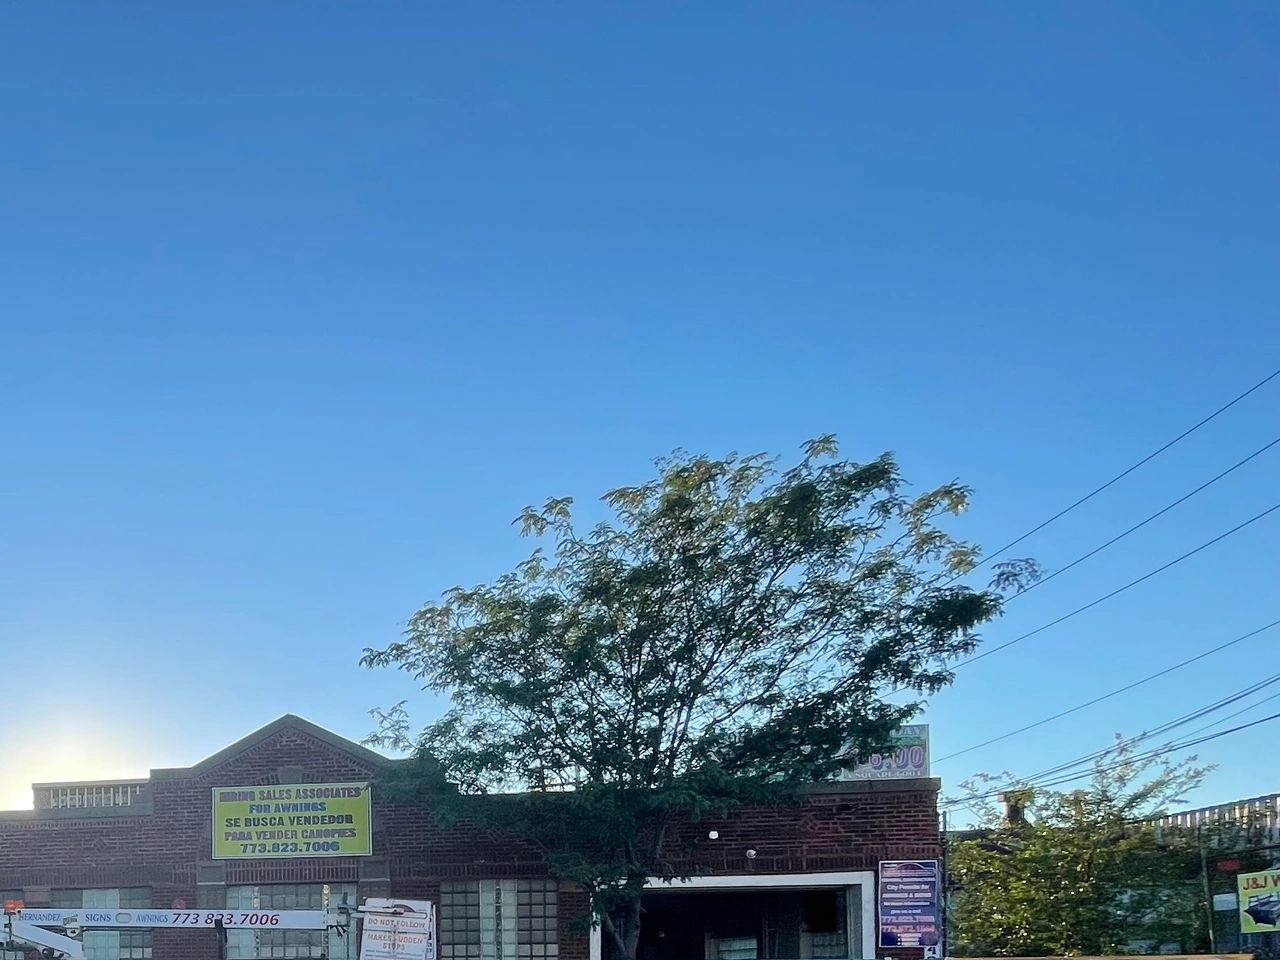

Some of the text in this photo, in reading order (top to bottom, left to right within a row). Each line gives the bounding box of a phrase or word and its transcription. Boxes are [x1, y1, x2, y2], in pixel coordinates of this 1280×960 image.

[259, 789, 292, 801] SALES
[295, 787, 362, 800] ASSOCIATES
[249, 802, 327, 814] FOR AWNINGS
[225, 814, 354, 828] SE BUSCA VENDEDOR
[224, 831, 253, 842] PARA
[256, 829, 298, 841] VENDER
[240, 841, 340, 854] 773.823.7006
[1243, 875, 1268, 890] J&J
[85, 913, 112, 922] SIGNS
[135, 914, 169, 923] AWNINGS
[172, 913, 200, 925] 773
[380, 919, 395, 927] NOT
[396, 920, 426, 929] FOLLOW
